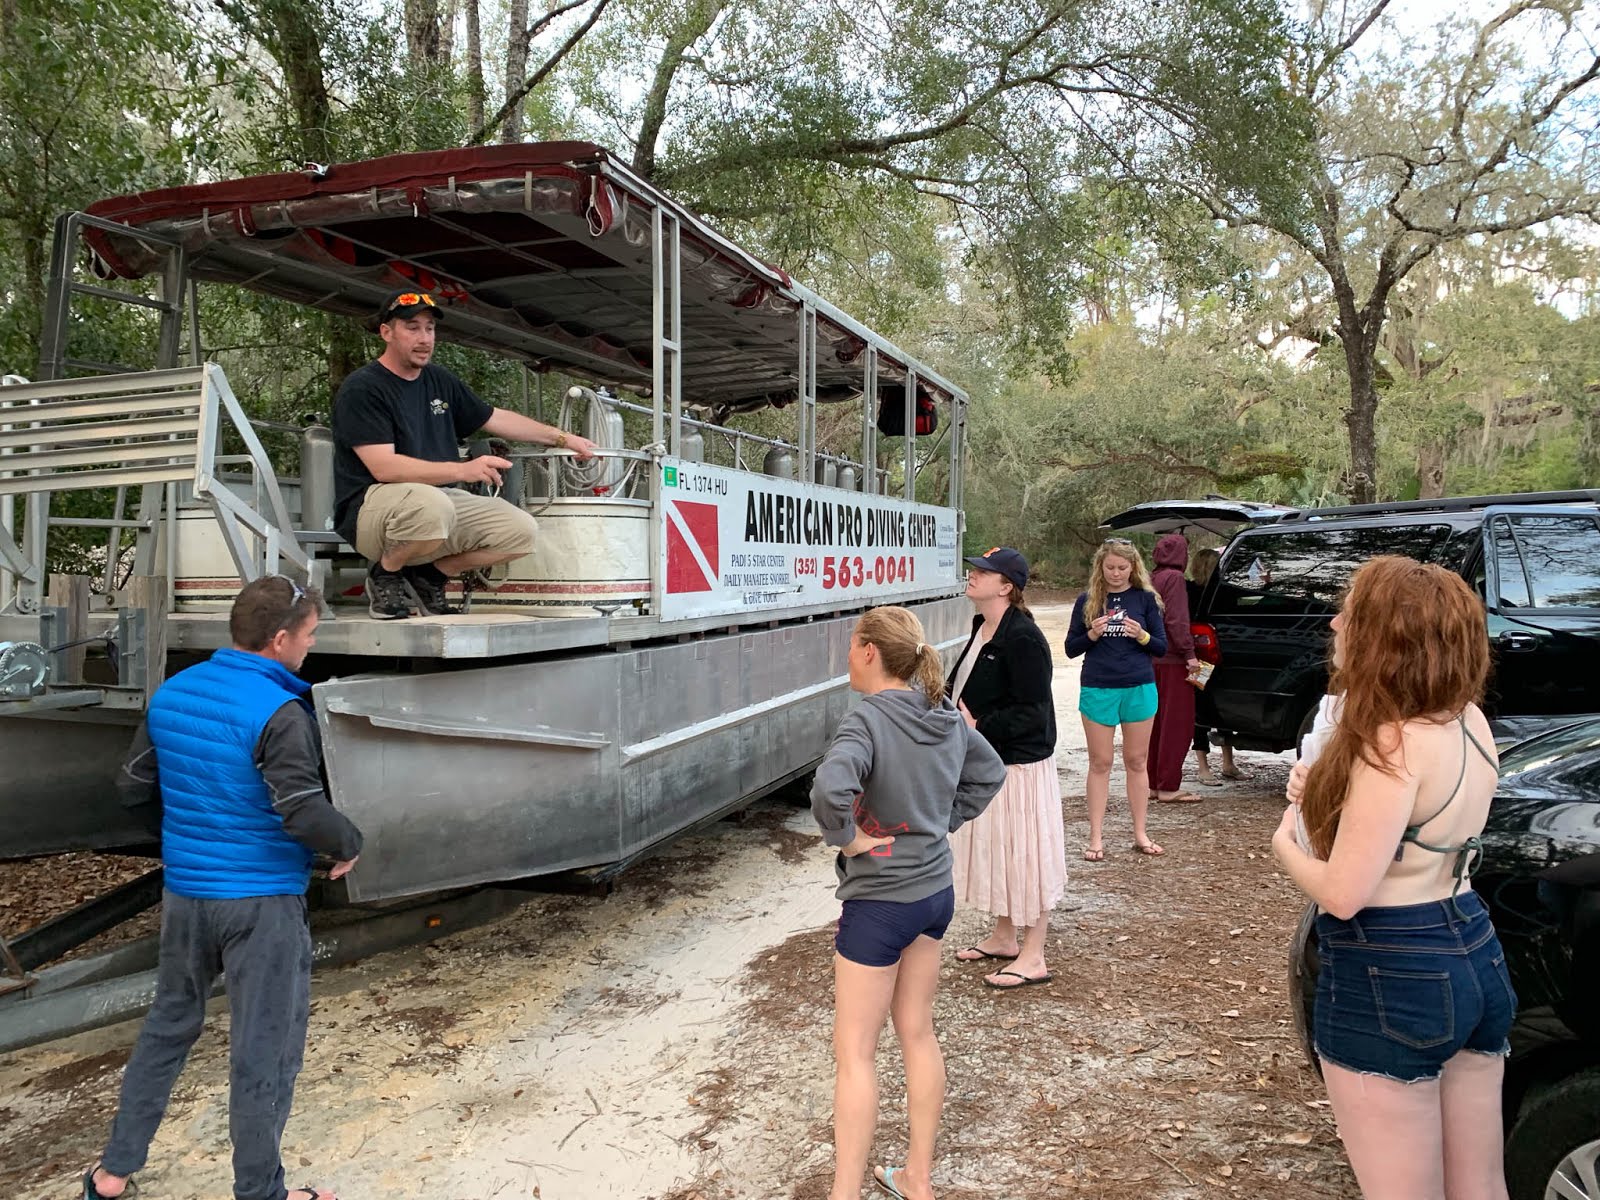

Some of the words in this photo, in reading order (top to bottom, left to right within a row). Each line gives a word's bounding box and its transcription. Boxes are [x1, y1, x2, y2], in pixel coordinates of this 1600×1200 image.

[679, 472, 691, 491] FL
[693, 474, 712, 494] 1374
[715, 478, 728, 496] HU
[745, 490, 833, 546] AMERICAN
[837, 505, 863, 547] PRO
[867, 508, 905, 548] DIVING
[908, 512, 937, 548] CENTER
[731, 554, 746, 568] PADI
[747, 554, 752, 567] 5
[752, 555, 767, 567] STAR
[767, 555, 785, 567] CENTER
[794, 557, 818, 579] (352)
[822, 556, 915, 590] 563-0041
[724, 574, 743, 587] DAILY
[743, 573, 769, 587] MANATEE
